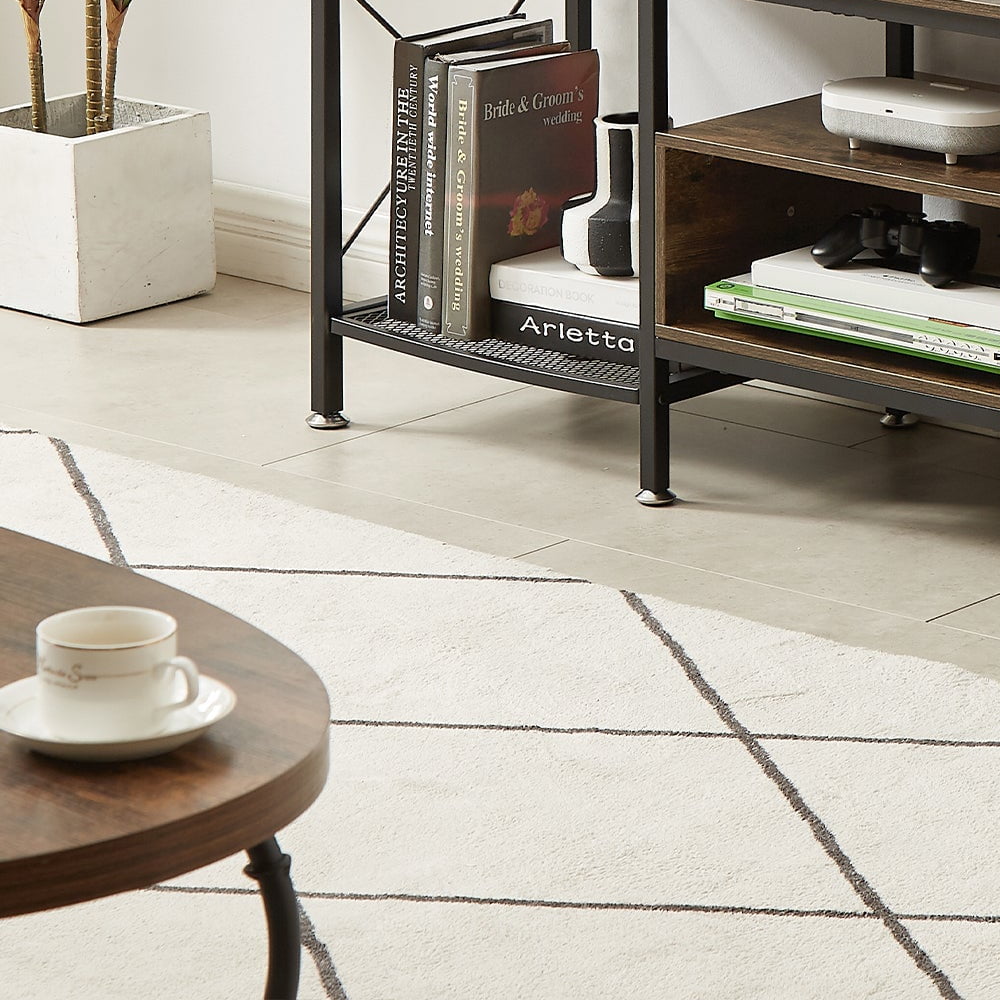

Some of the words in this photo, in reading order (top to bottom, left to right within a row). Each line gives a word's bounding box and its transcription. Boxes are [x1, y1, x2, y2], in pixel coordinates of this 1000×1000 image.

[397, 87, 409, 127] THE
[408, 64, 418, 118] CENTURY
[427, 75, 439, 128] World
[484, 99, 516, 121] Bride
[517, 95, 529, 114] &
[458, 100, 467, 144] Bride
[543, 110, 583, 127] wedding
[396, 131, 409, 153] IN
[408, 122, 417, 190] TWENTIETH
[426, 131, 437, 169] wide
[457, 149, 467, 164] &
[425, 171, 437, 237] internet
[452, 247, 463, 311] wedding
[499, 280, 563, 299] DECORATION
[565, 290, 594, 304] BOOK
[520, 316, 635, 353] Arletta
